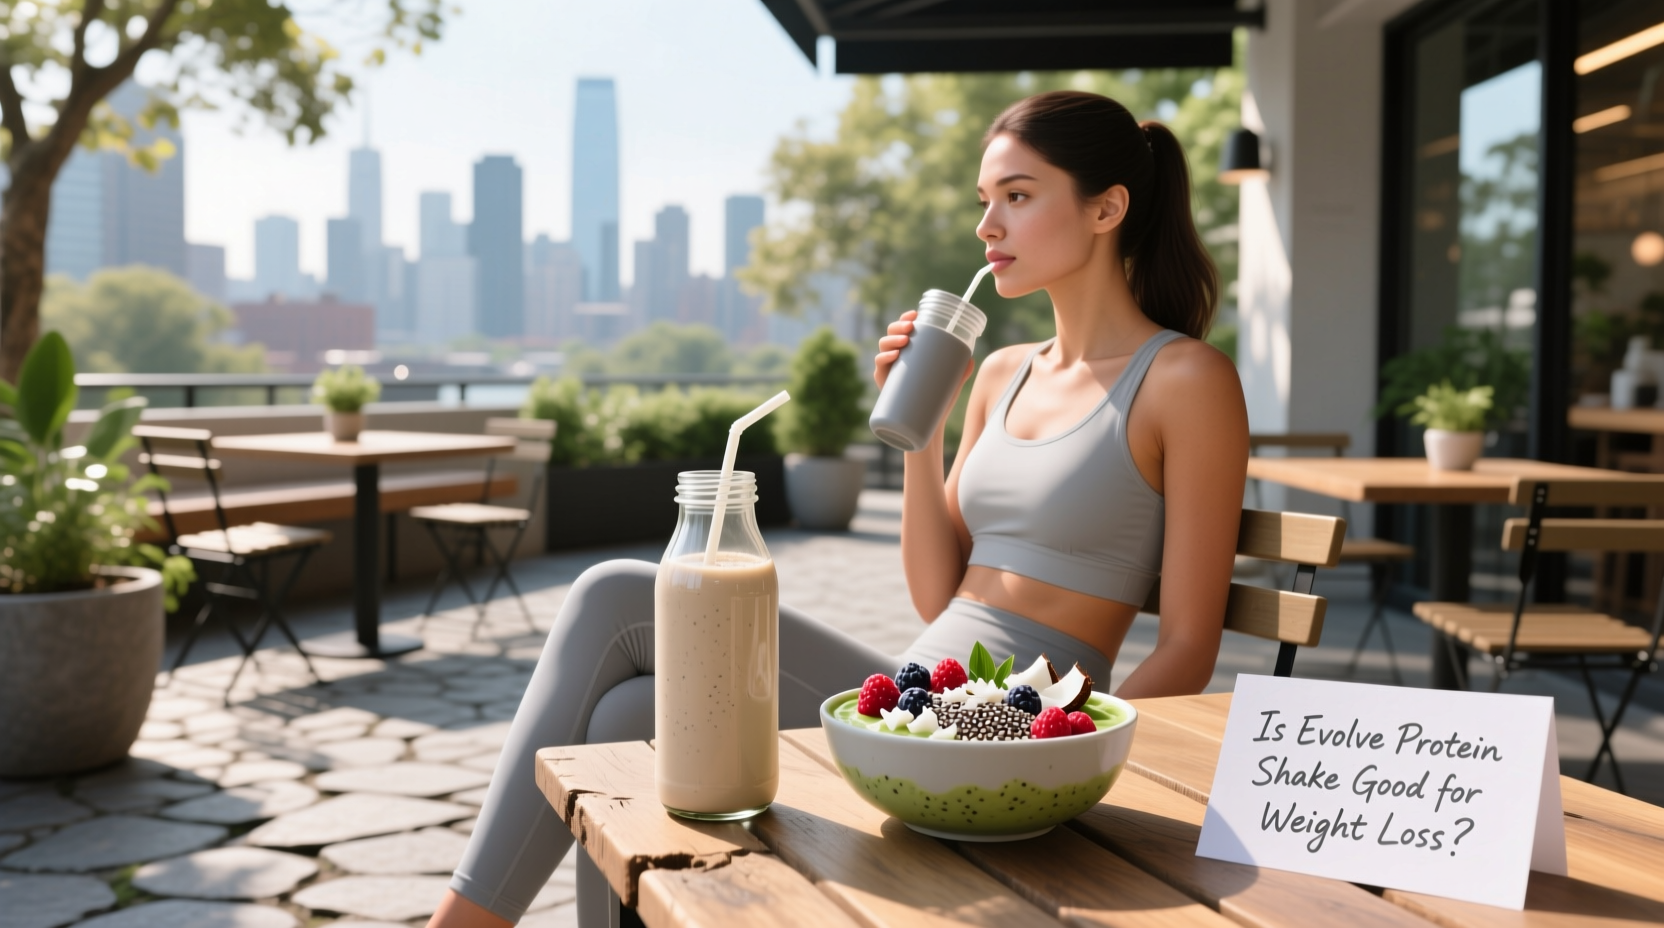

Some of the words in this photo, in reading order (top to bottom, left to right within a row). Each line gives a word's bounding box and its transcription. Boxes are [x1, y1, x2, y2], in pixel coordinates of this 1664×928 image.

[1252, 710, 1287, 742] Is
[1297, 714, 1385, 750] Evolve
[1395, 722, 1503, 762] Protein
[1251, 755, 1341, 790] Shake
[1352, 764, 1430, 804] Good
[1434, 773, 1483, 813] for
[1260, 801, 1368, 853] Weight
[1377, 812, 1475, 857] Loss?
